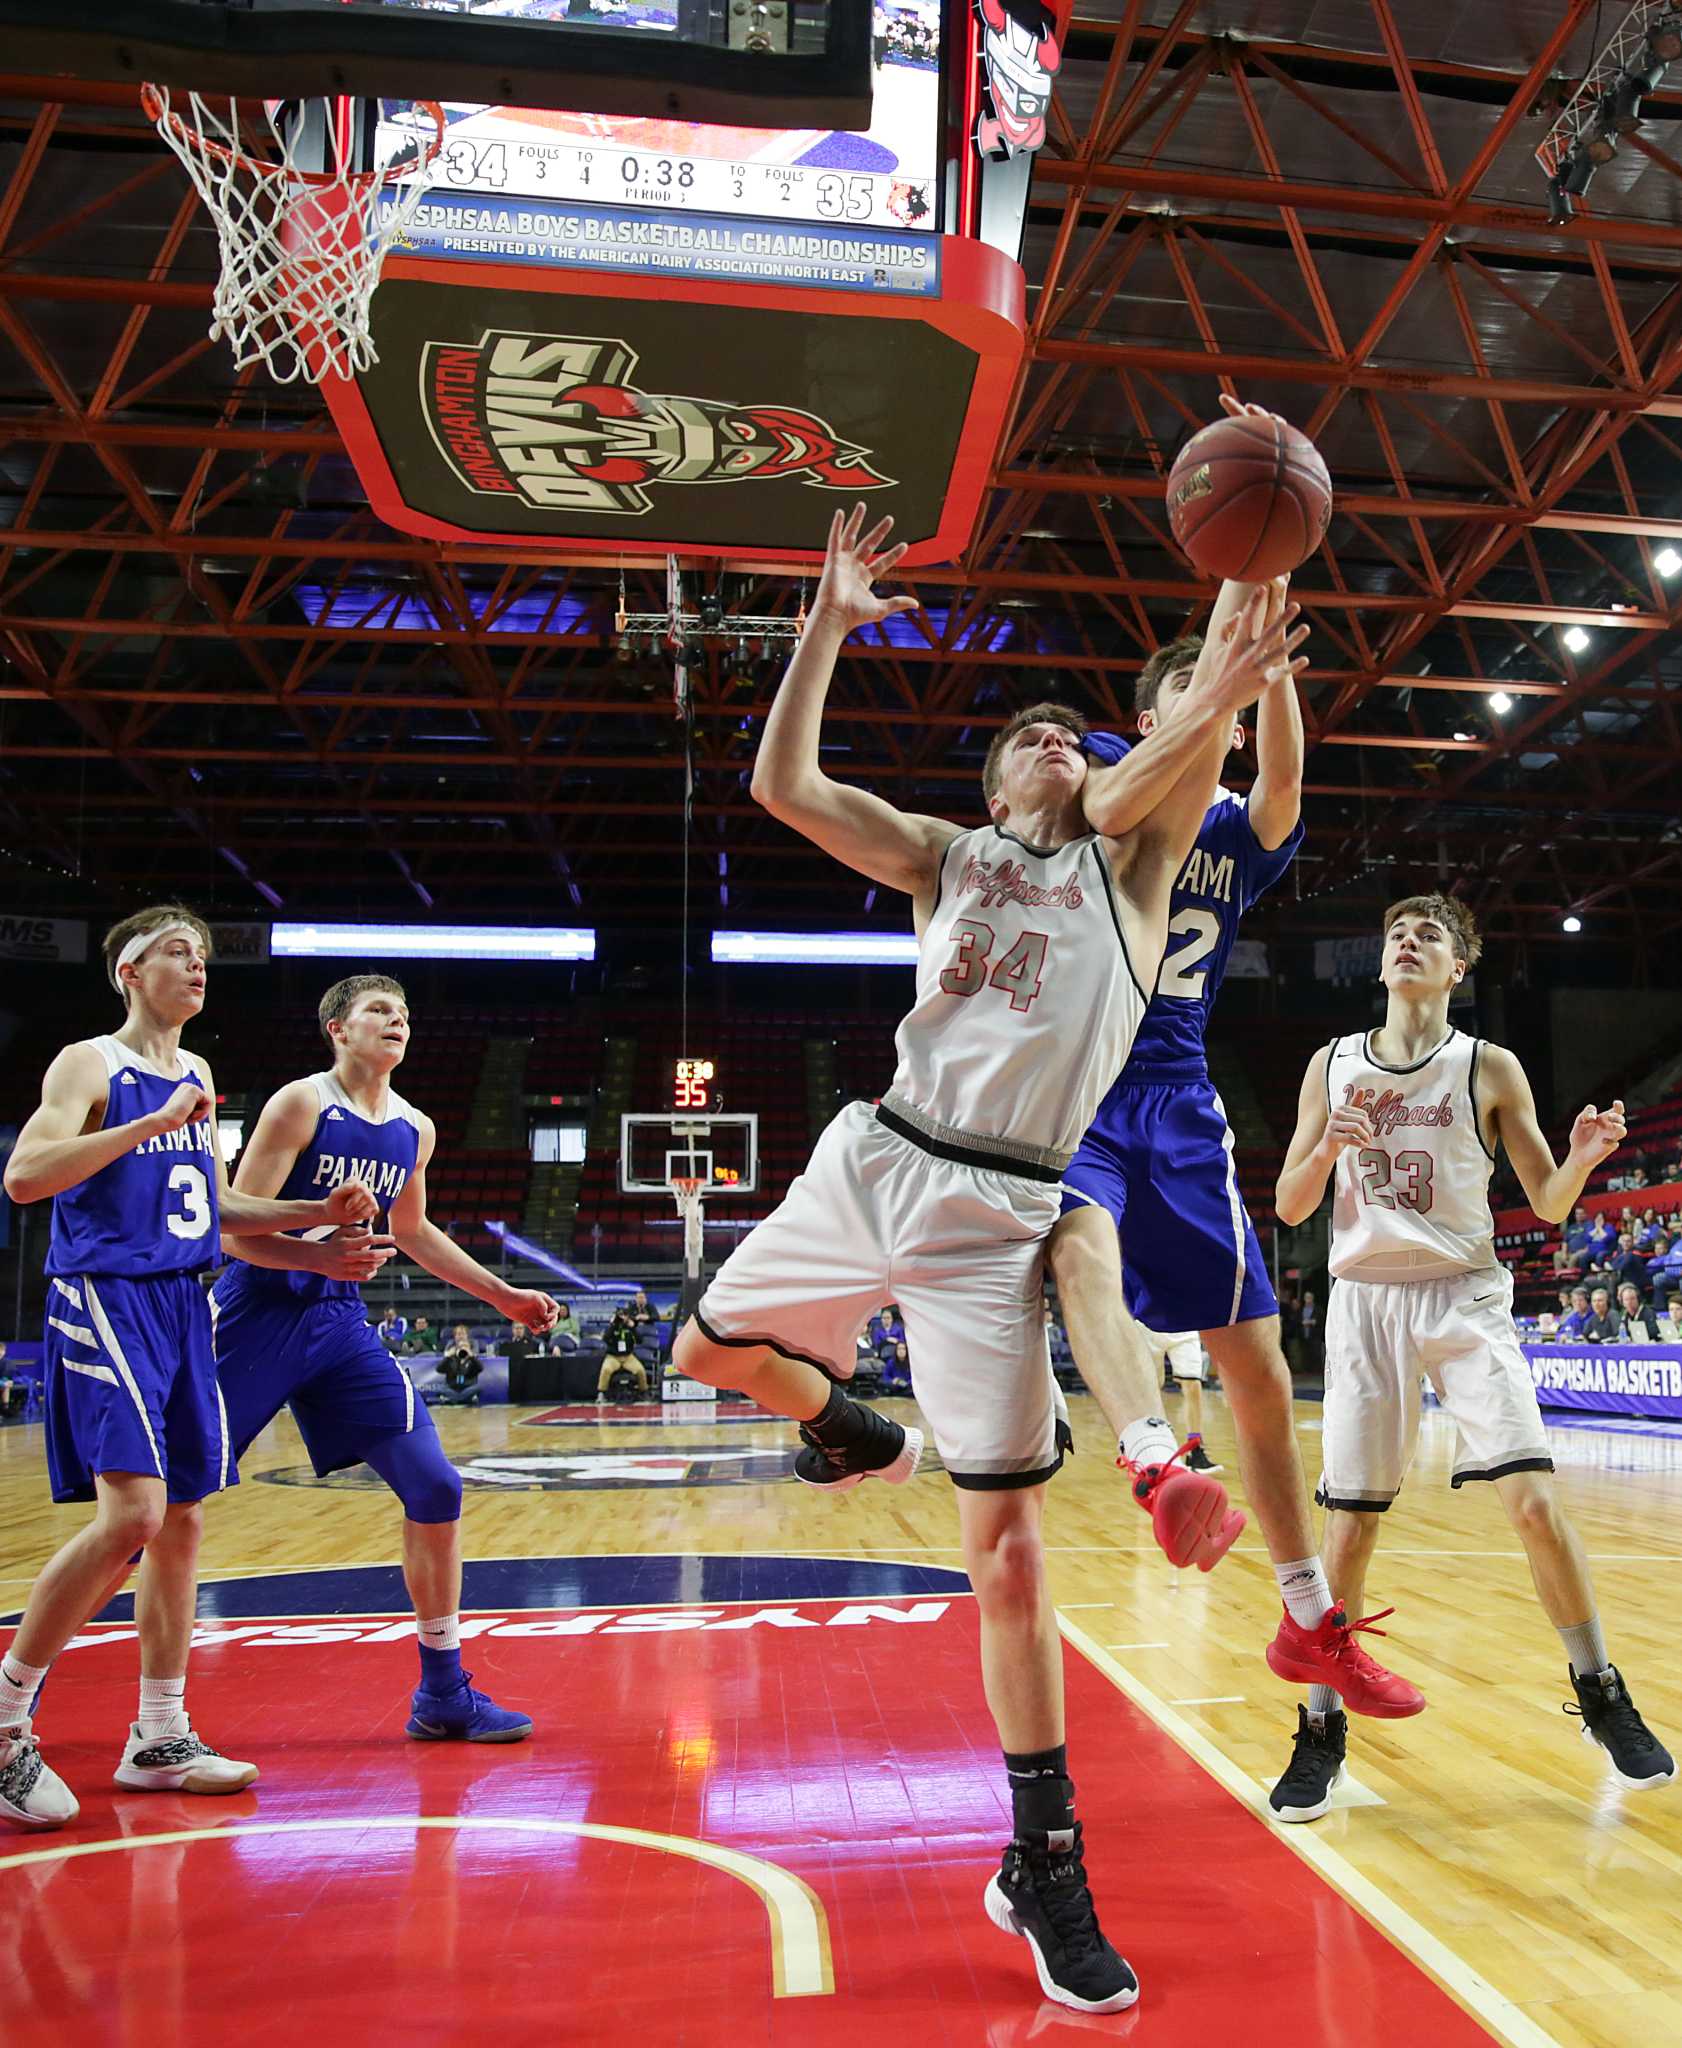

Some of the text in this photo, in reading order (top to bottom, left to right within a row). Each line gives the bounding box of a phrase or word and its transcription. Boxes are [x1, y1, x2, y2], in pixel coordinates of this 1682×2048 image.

[446, 140, 508, 187] 34
[519, 146, 559, 160] FOULS
[536, 160, 546, 179] 3
[578, 151, 593, 163] TO
[621, 156, 695, 188] 0:38
[730, 165, 746, 177] TO
[580, 166, 590, 185] 4
[733, 180, 743, 198] 3
[765, 168, 804, 183] FOULS
[780, 183, 791, 201] 2
[816, 174, 874, 220] 35
[444, 237, 866, 283] PRESENTED BY THE AMERICAN DAIRY ASSOCIATION NORTH EAST
[517, 212, 579, 240] BOYS
[584, 218, 737, 252] BASKETBALL
[741, 232, 927, 268] CHAMPIONSHIPS
[435, 349, 517, 491] BINGHAMTON
[485, 337, 624, 510] DEVILS
[939, 918, 1048, 1012] 34
[1157, 907, 1220, 998] 2
[675, 1079, 706, 1107] 35
[312, 1153, 407, 1199] PANAMA
[1358, 1148, 1434, 1214] 23
[167, 1164, 211, 1239] 3
[1606, 1359, 1682, 1398] BASKETB
